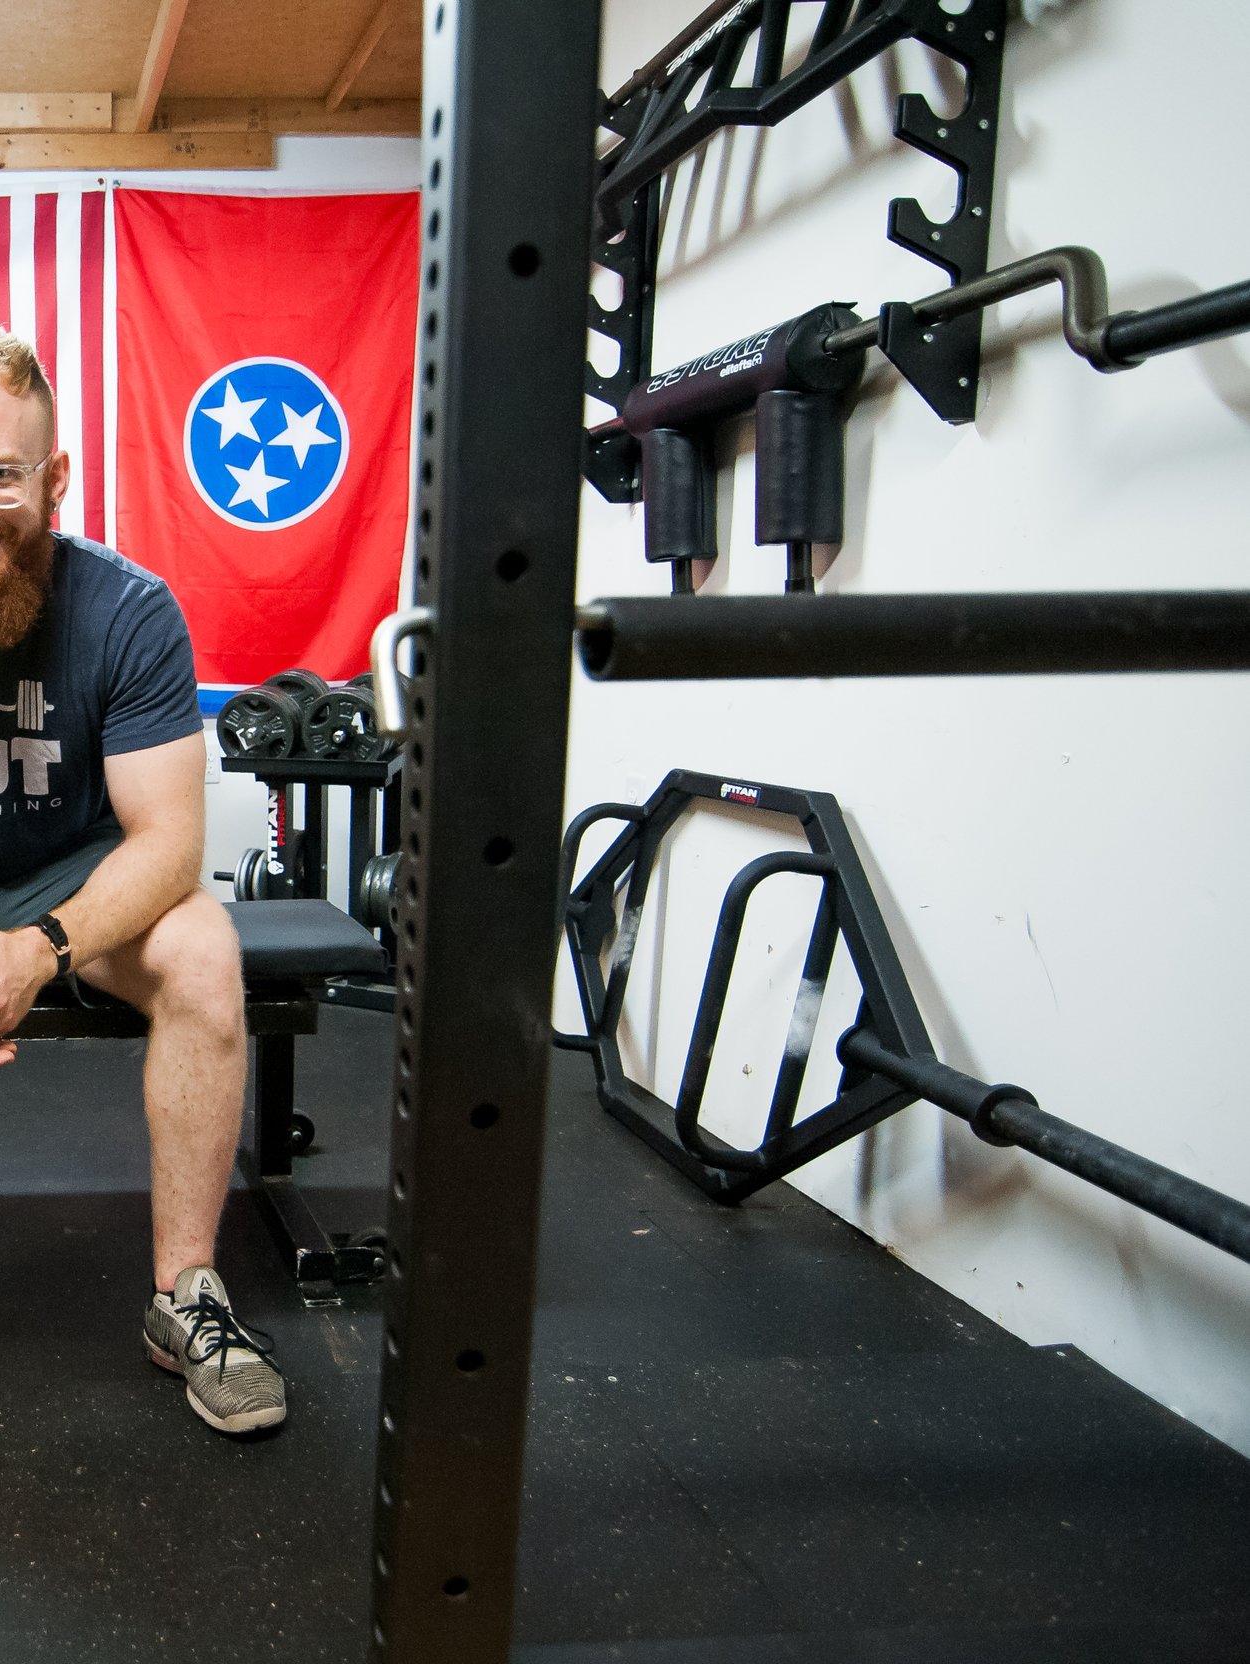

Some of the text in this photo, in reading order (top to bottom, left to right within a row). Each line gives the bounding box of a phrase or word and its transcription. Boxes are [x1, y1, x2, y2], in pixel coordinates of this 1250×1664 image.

[719, 360, 753, 378] elitefts
[726, 784, 757, 798] TITAN
[267, 789, 278, 861] TITAN
